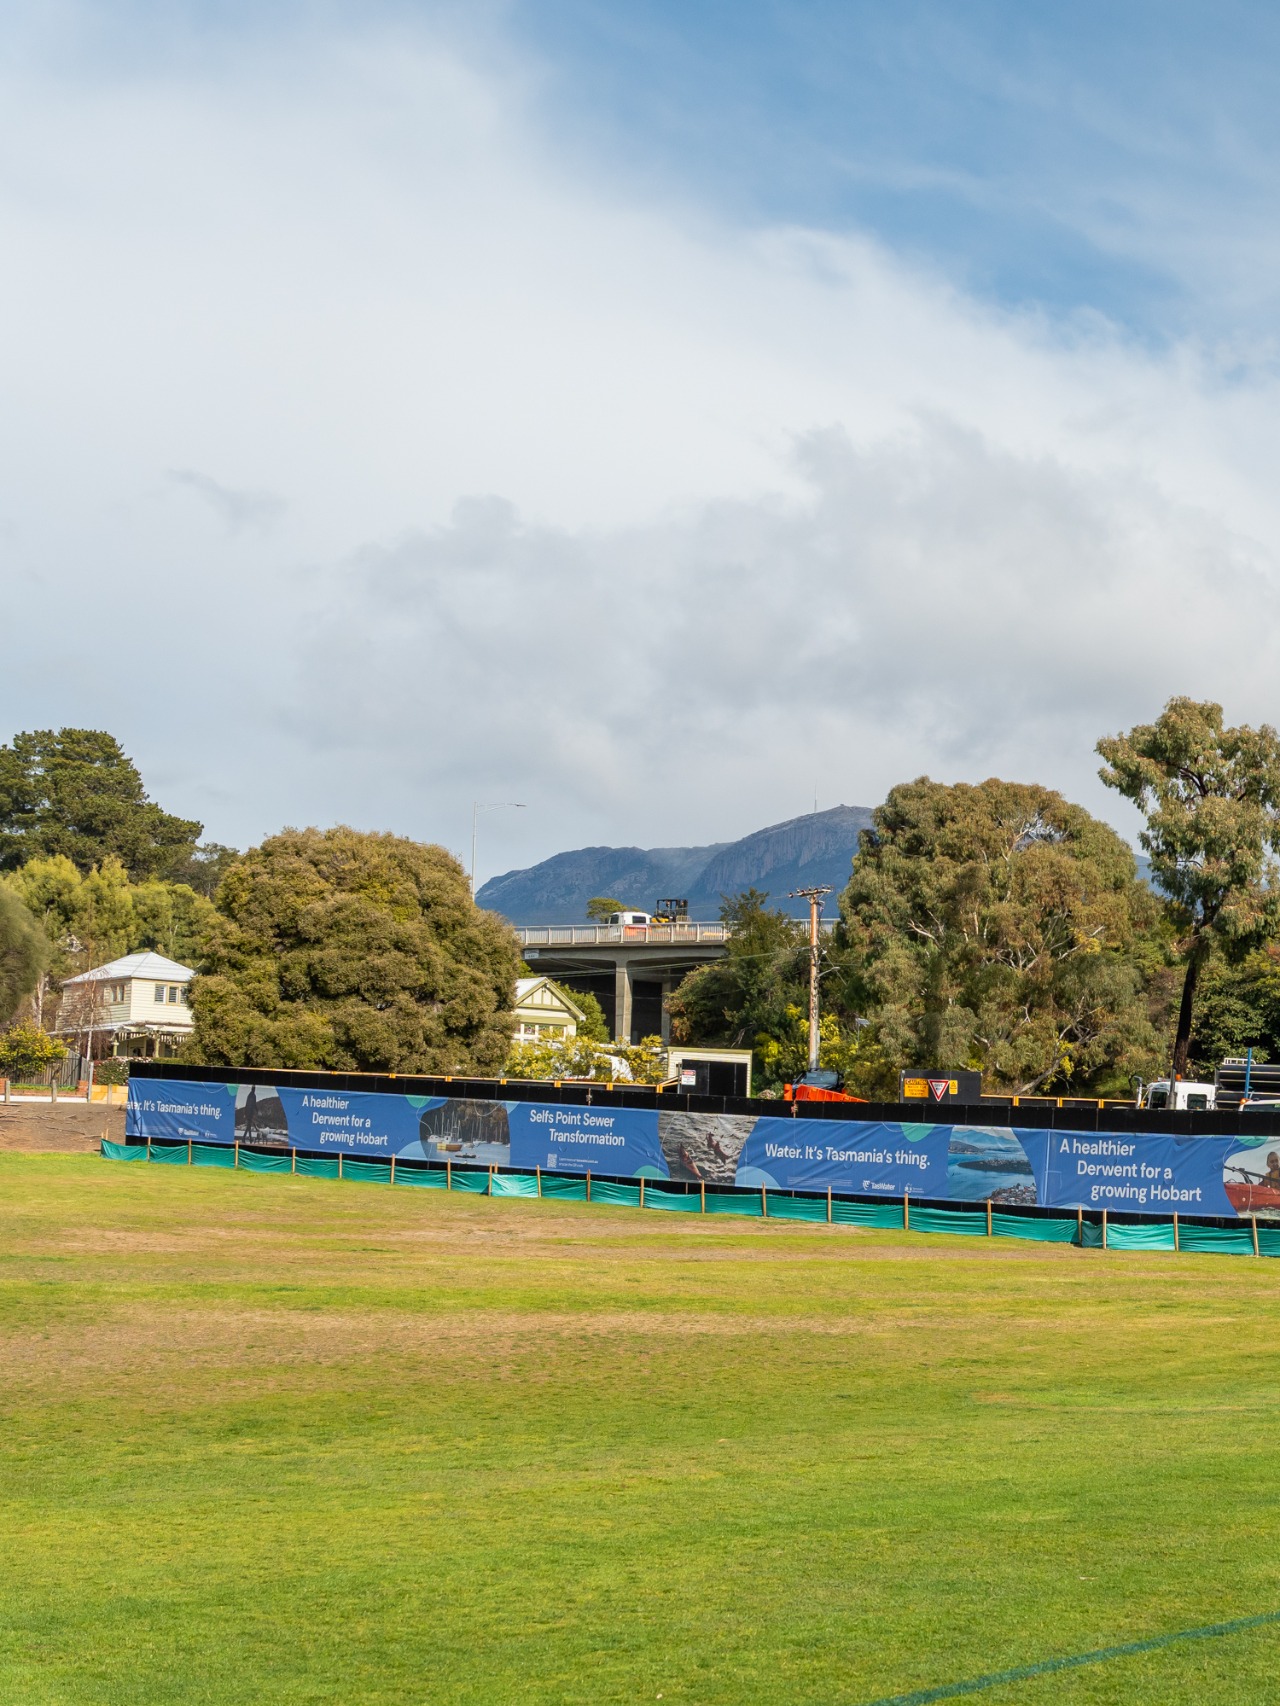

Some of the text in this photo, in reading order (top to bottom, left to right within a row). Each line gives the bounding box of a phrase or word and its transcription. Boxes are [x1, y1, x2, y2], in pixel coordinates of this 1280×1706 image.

[143, 1100, 155, 1112] It's
[157, 1101, 199, 1115] Tasmania's
[200, 1104, 222, 1120] thing.
[302, 1095, 349, 1110] A healthier
[312, 1112, 371, 1128] Derwent for a
[530, 1110, 615, 1127] Selfs Point Sewer
[319, 1131, 388, 1146] growing Hobart
[549, 1129, 625, 1146] Transformation
[1060, 1138, 1135, 1156] A healthier
[765, 1143, 930, 1169] Water. It's Tasmania's thing.
[1077, 1160, 1172, 1180] Derwent for a
[1091, 1184, 1201, 1203] growing Hobart
